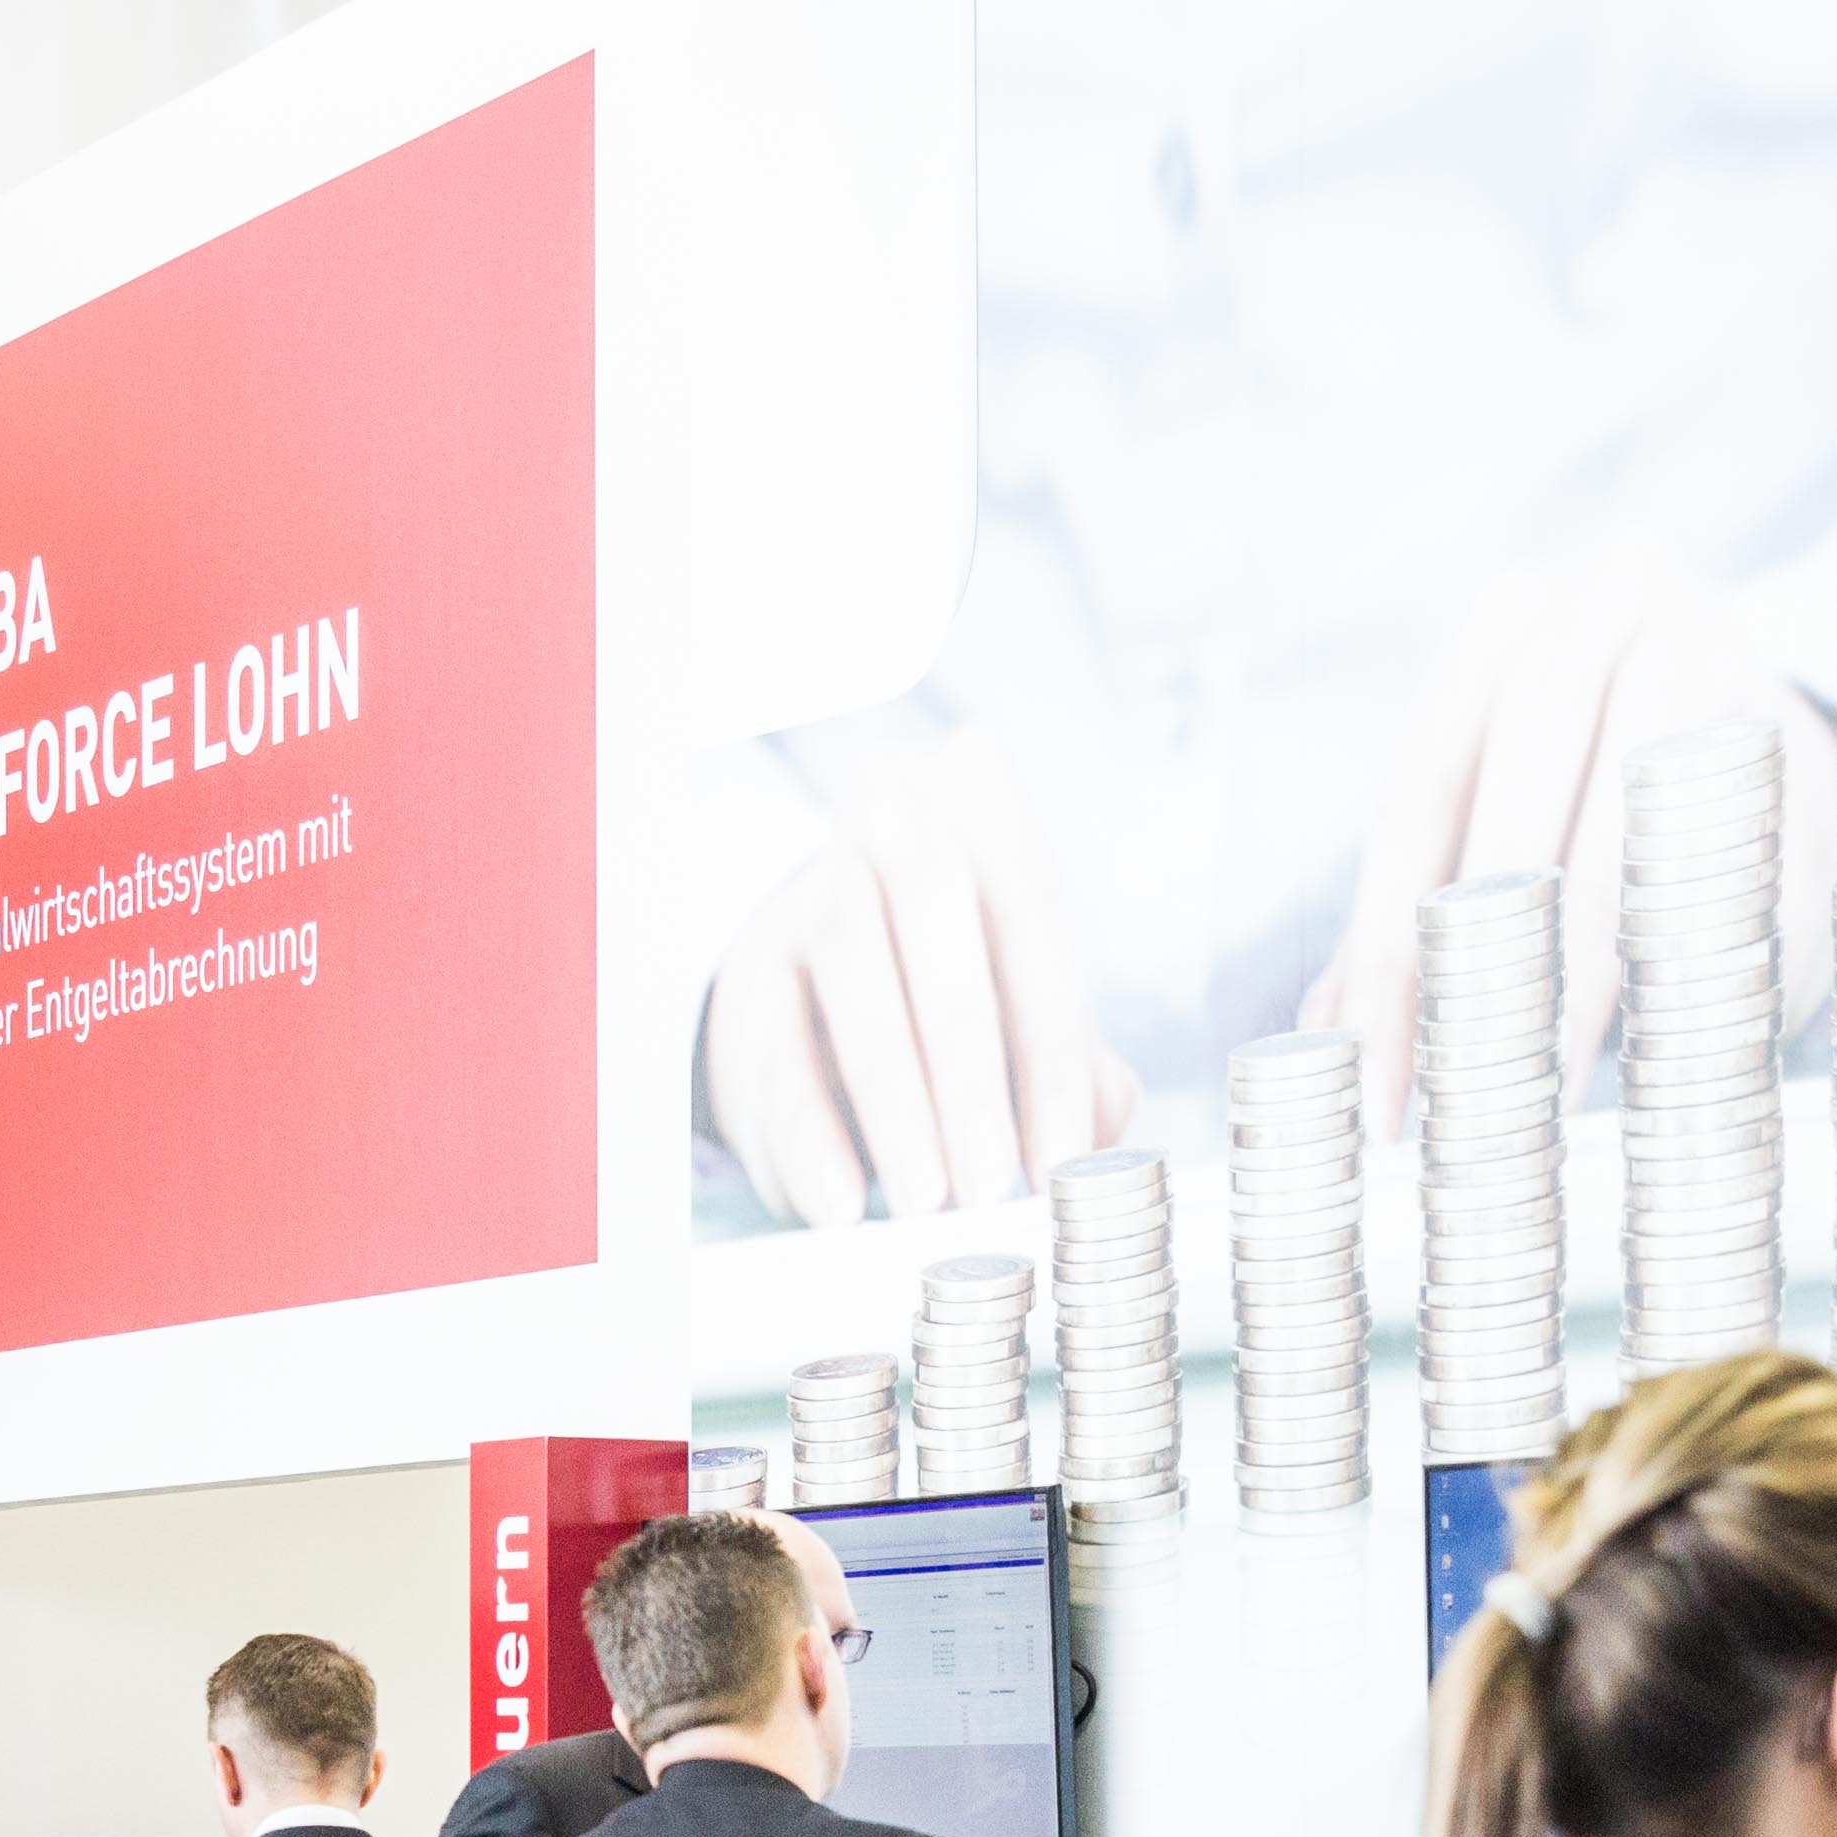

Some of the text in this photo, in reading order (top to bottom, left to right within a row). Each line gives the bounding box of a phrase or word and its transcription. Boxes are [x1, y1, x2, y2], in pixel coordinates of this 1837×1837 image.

[193, 606, 360, 771] LOHN
[298, 793, 353, 867] mit
[26, 920, 318, 1043] Entgeltabrechnung
[495, 1515, 530, 1751] uern
